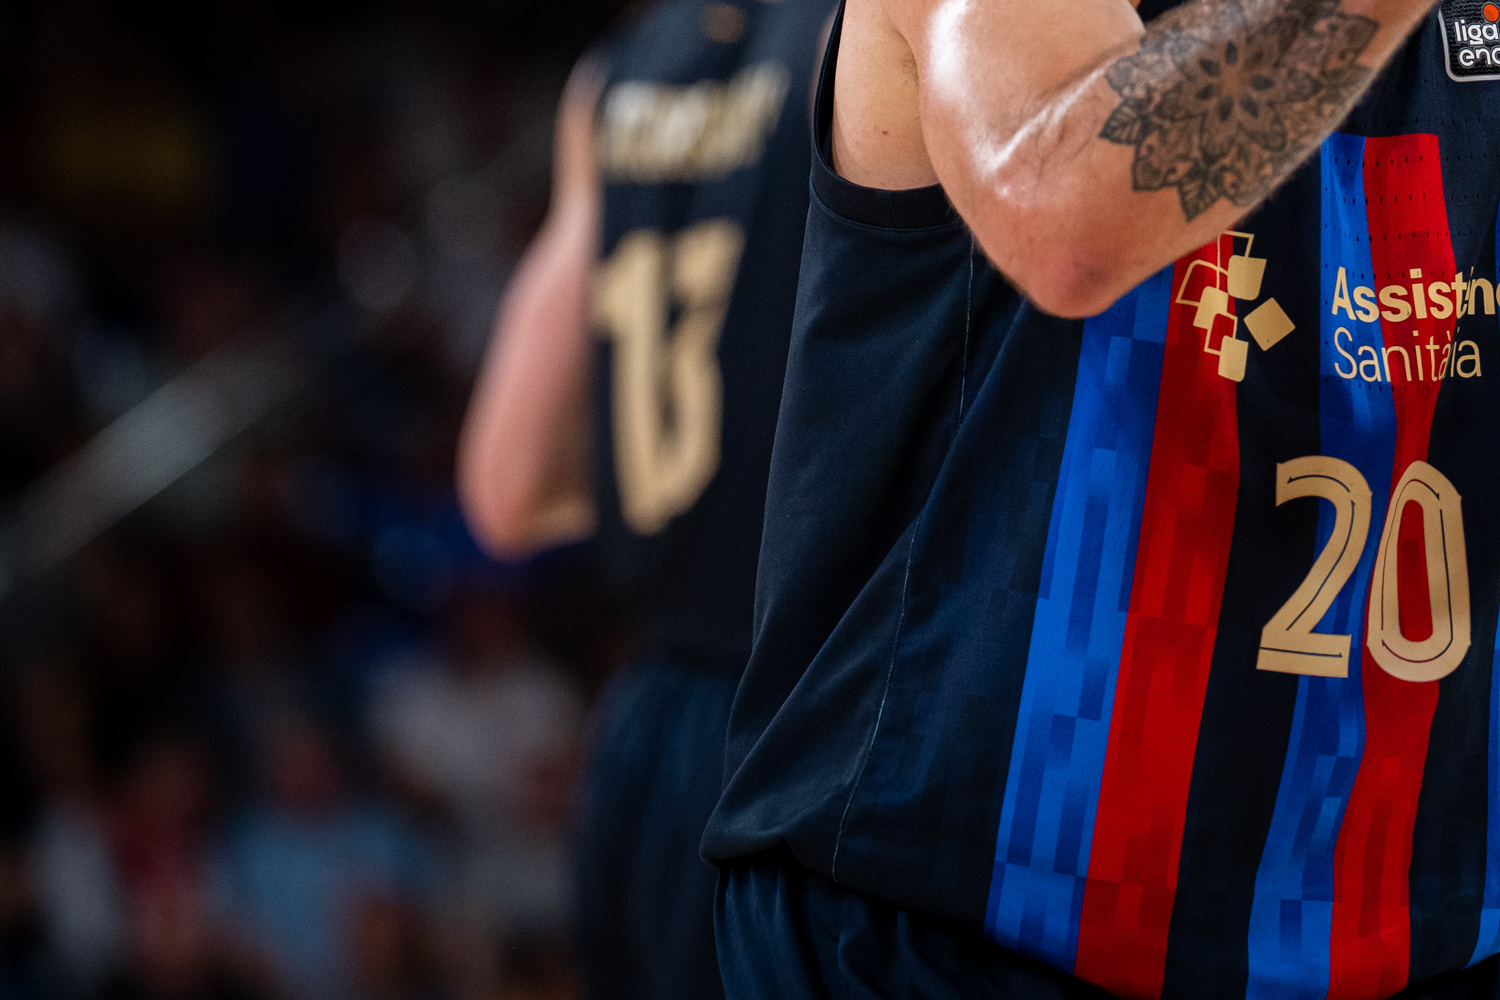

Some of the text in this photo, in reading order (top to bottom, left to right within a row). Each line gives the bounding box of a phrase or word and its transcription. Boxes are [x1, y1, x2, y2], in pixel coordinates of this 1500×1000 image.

[1454, 18, 1500, 46] liga
[1333, 326, 1482, 383] Sanitàia
[1256, 455, 1472, 683] 20
